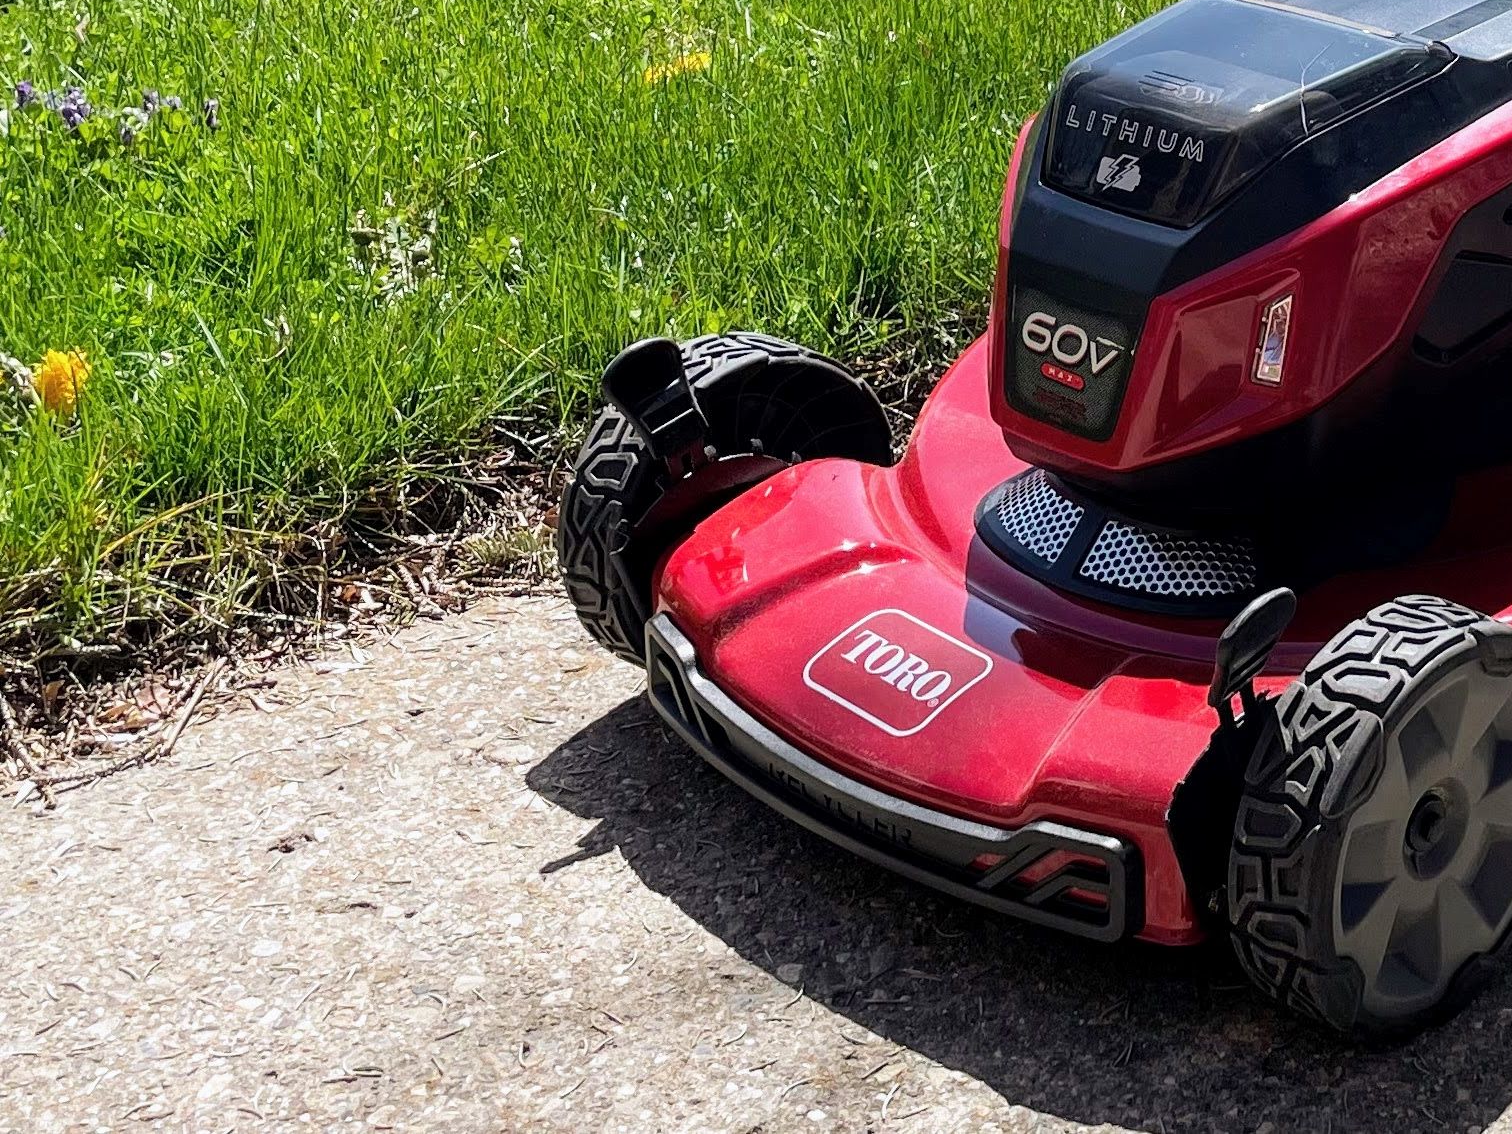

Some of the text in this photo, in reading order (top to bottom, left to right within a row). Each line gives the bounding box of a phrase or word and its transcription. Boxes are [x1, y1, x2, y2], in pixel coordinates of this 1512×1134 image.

[1065, 104, 1204, 162] LITHIUM
[1022, 311, 1119, 374] 60V
[841, 629, 952, 701] TORO
